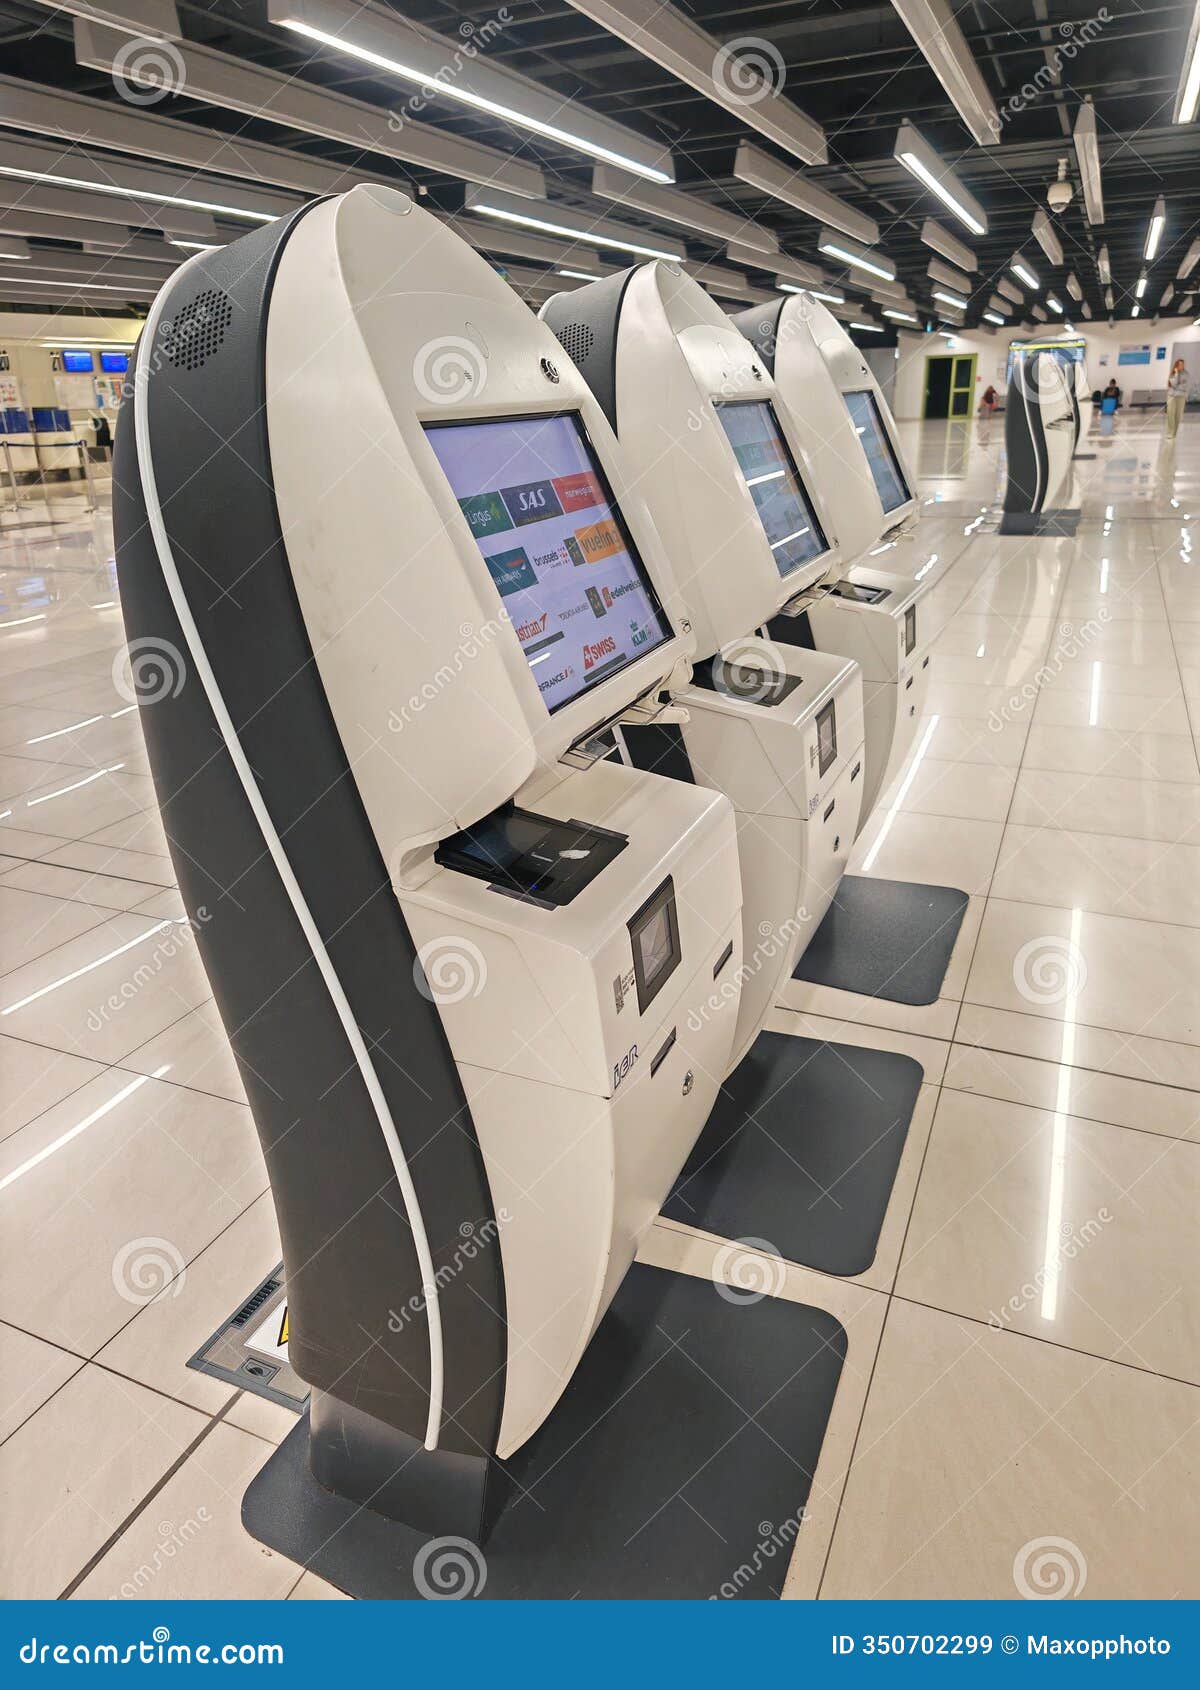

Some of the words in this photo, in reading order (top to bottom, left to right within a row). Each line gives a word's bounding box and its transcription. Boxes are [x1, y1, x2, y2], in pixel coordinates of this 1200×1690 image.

[519, 488, 546, 512] SAS
[590, 636, 616, 661] SWISS
[631, 630, 648, 647] KLM
